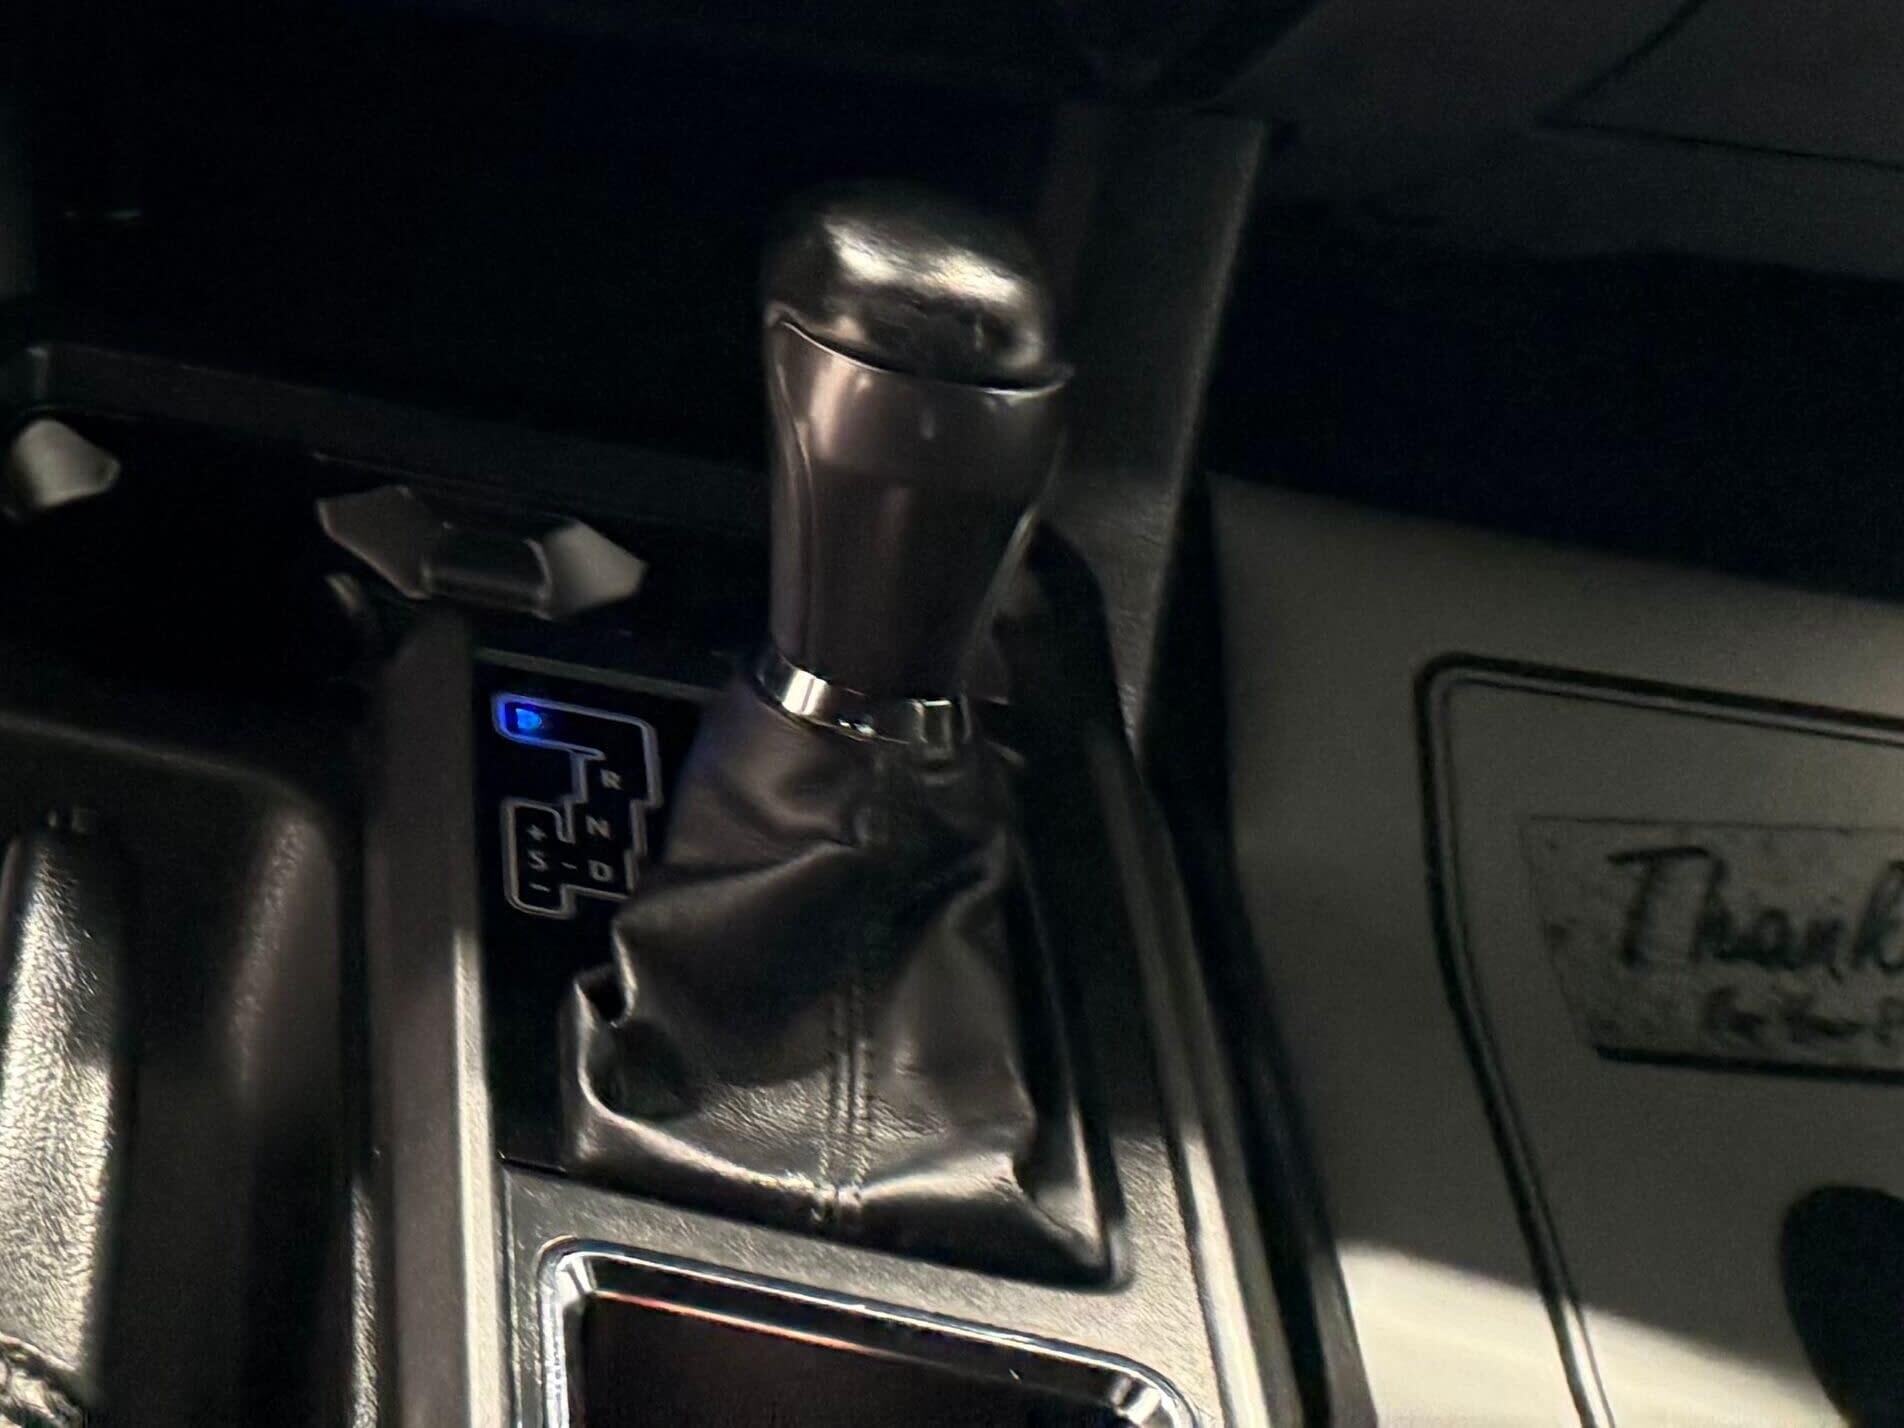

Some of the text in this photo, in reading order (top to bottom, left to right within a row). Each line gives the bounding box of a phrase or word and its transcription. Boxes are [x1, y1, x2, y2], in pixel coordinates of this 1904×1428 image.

[600, 769, 622, 790] R
[585, 815, 612, 839] N
[527, 850, 548, 872] S
[589, 860, 613, 882] D
